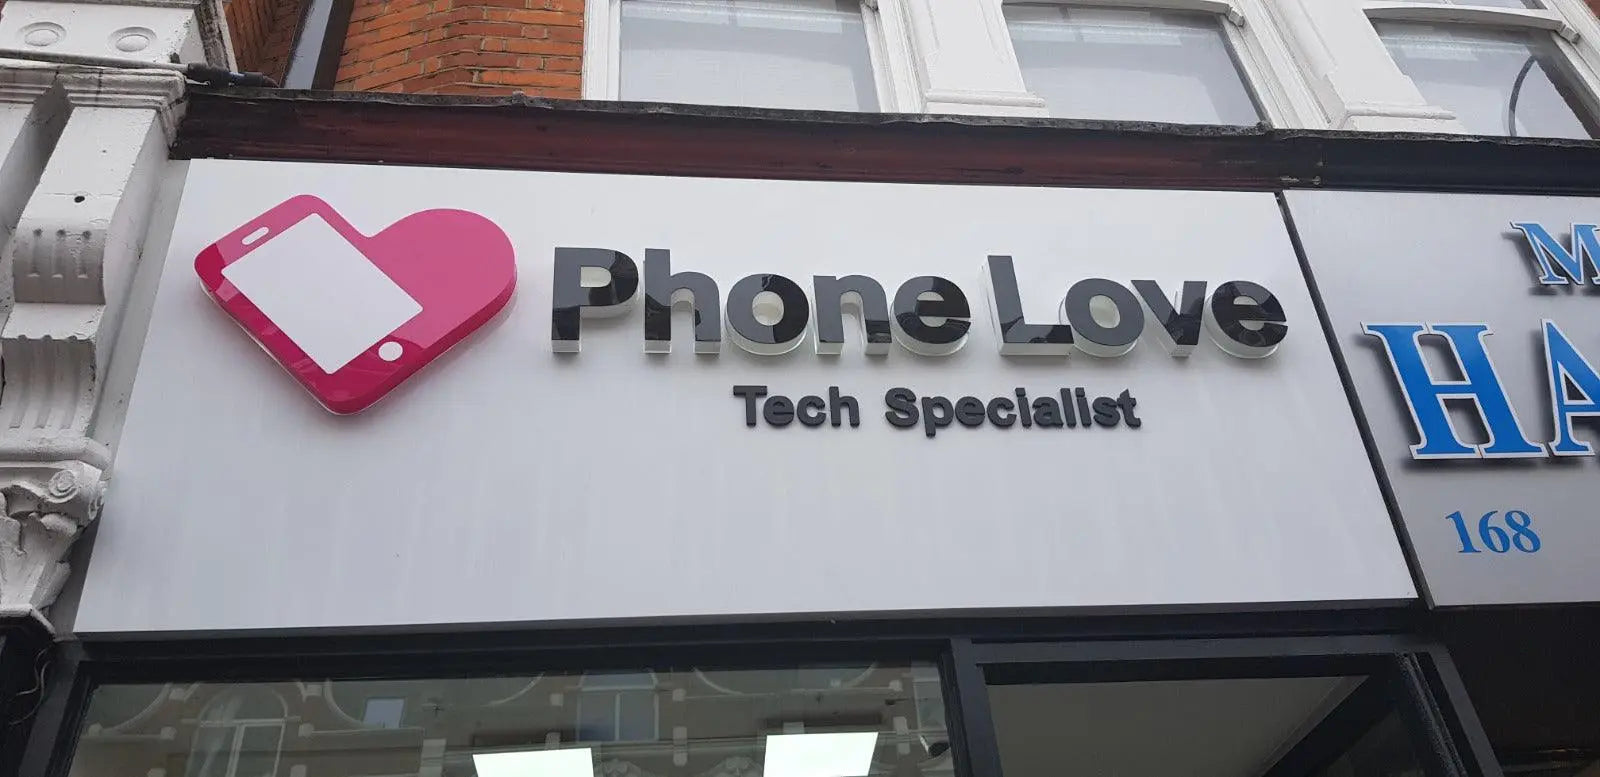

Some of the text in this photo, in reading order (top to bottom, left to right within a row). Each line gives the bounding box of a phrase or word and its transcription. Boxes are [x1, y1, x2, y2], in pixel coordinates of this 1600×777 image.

[551, 246, 1289, 357] Phone Love
[733, 384, 1141, 437] Tech Specialist
[1445, 509, 1541, 554] 168
